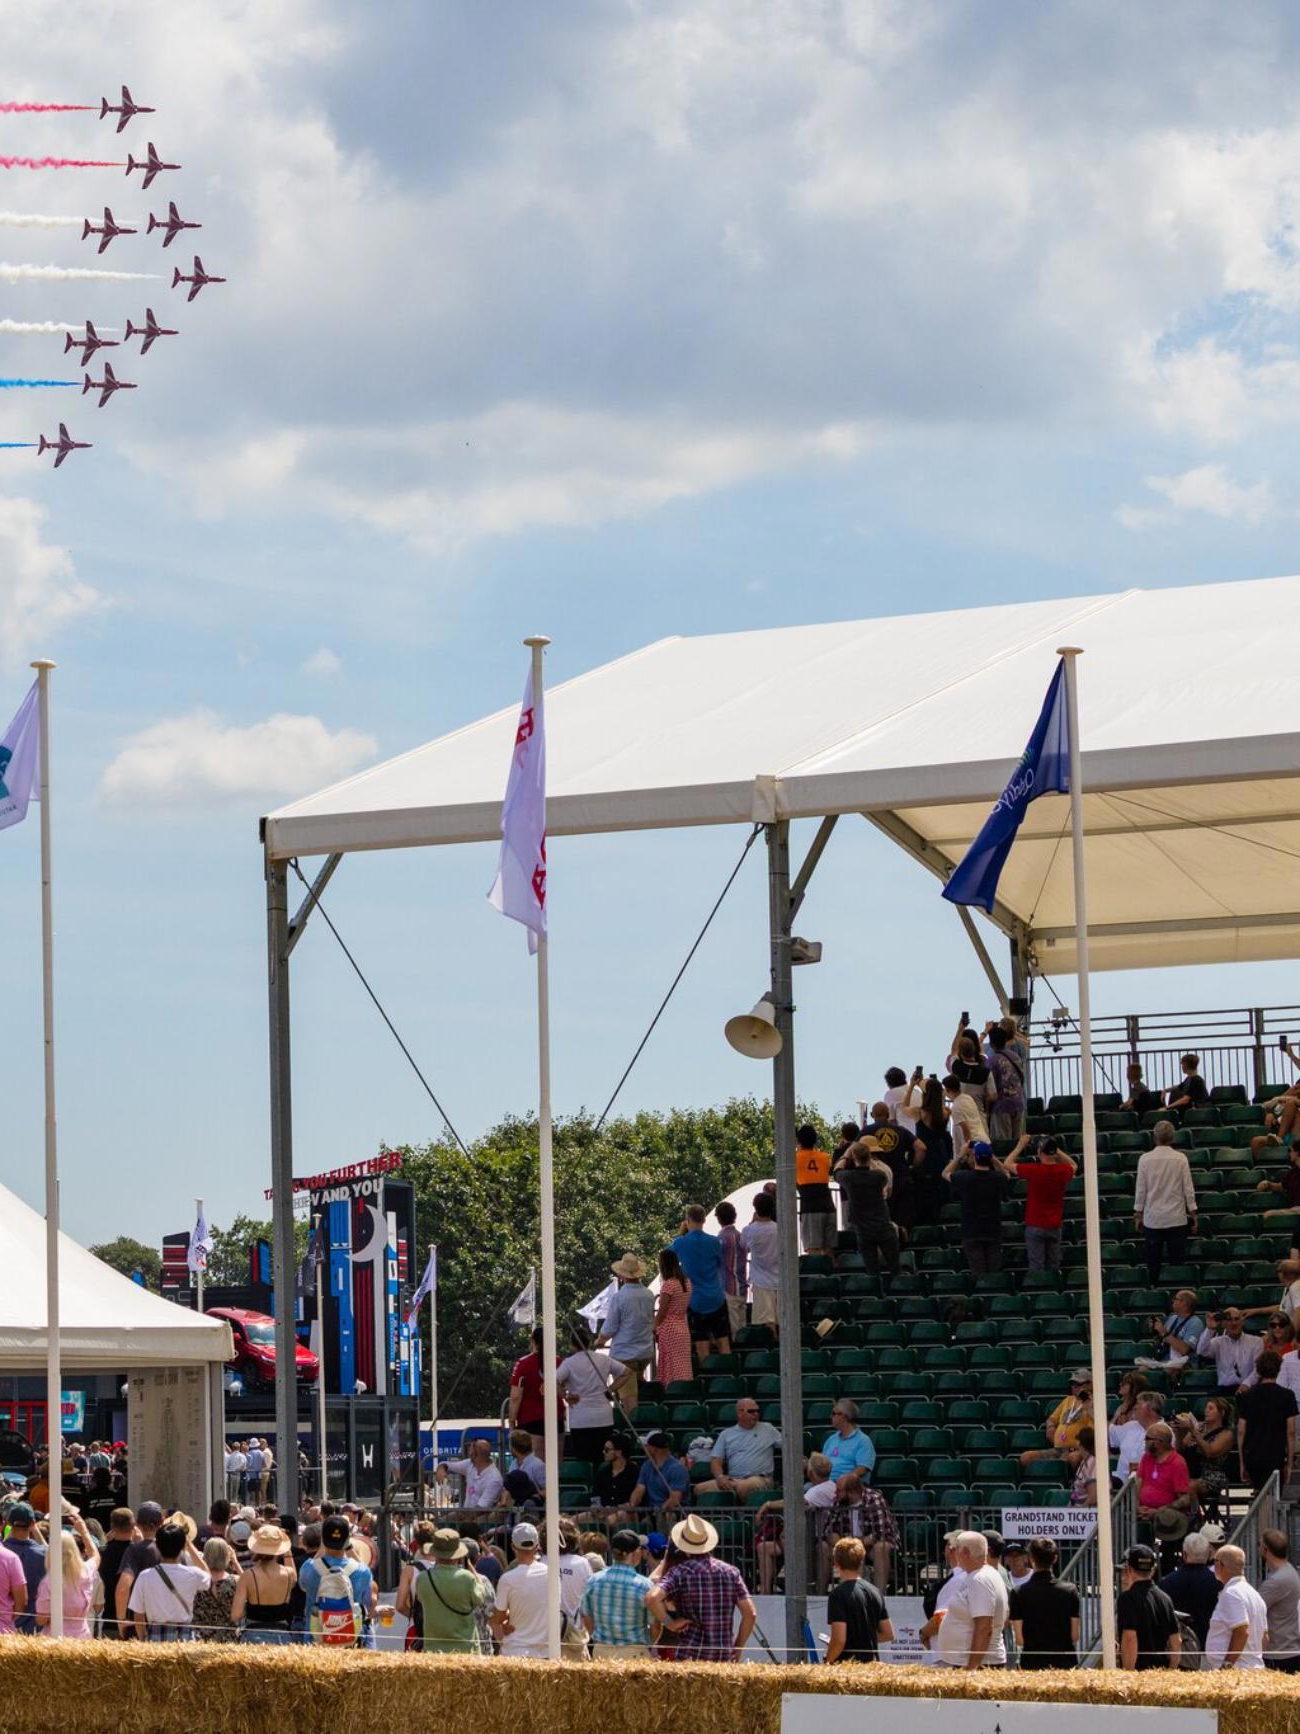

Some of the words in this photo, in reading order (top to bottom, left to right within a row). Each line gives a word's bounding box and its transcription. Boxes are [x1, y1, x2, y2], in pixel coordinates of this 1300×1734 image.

[328, 1150, 403, 1185] FURTHER
[807, 1159, 819, 1174] 4
[321, 1186, 350, 1205] AND
[352, 1178, 385, 1198] YOU
[1004, 1511, 1065, 1522] GRANDSTAND
[1017, 1525, 1059, 1535] HOLDERS
[1061, 1525, 1086, 1535] ONLY
